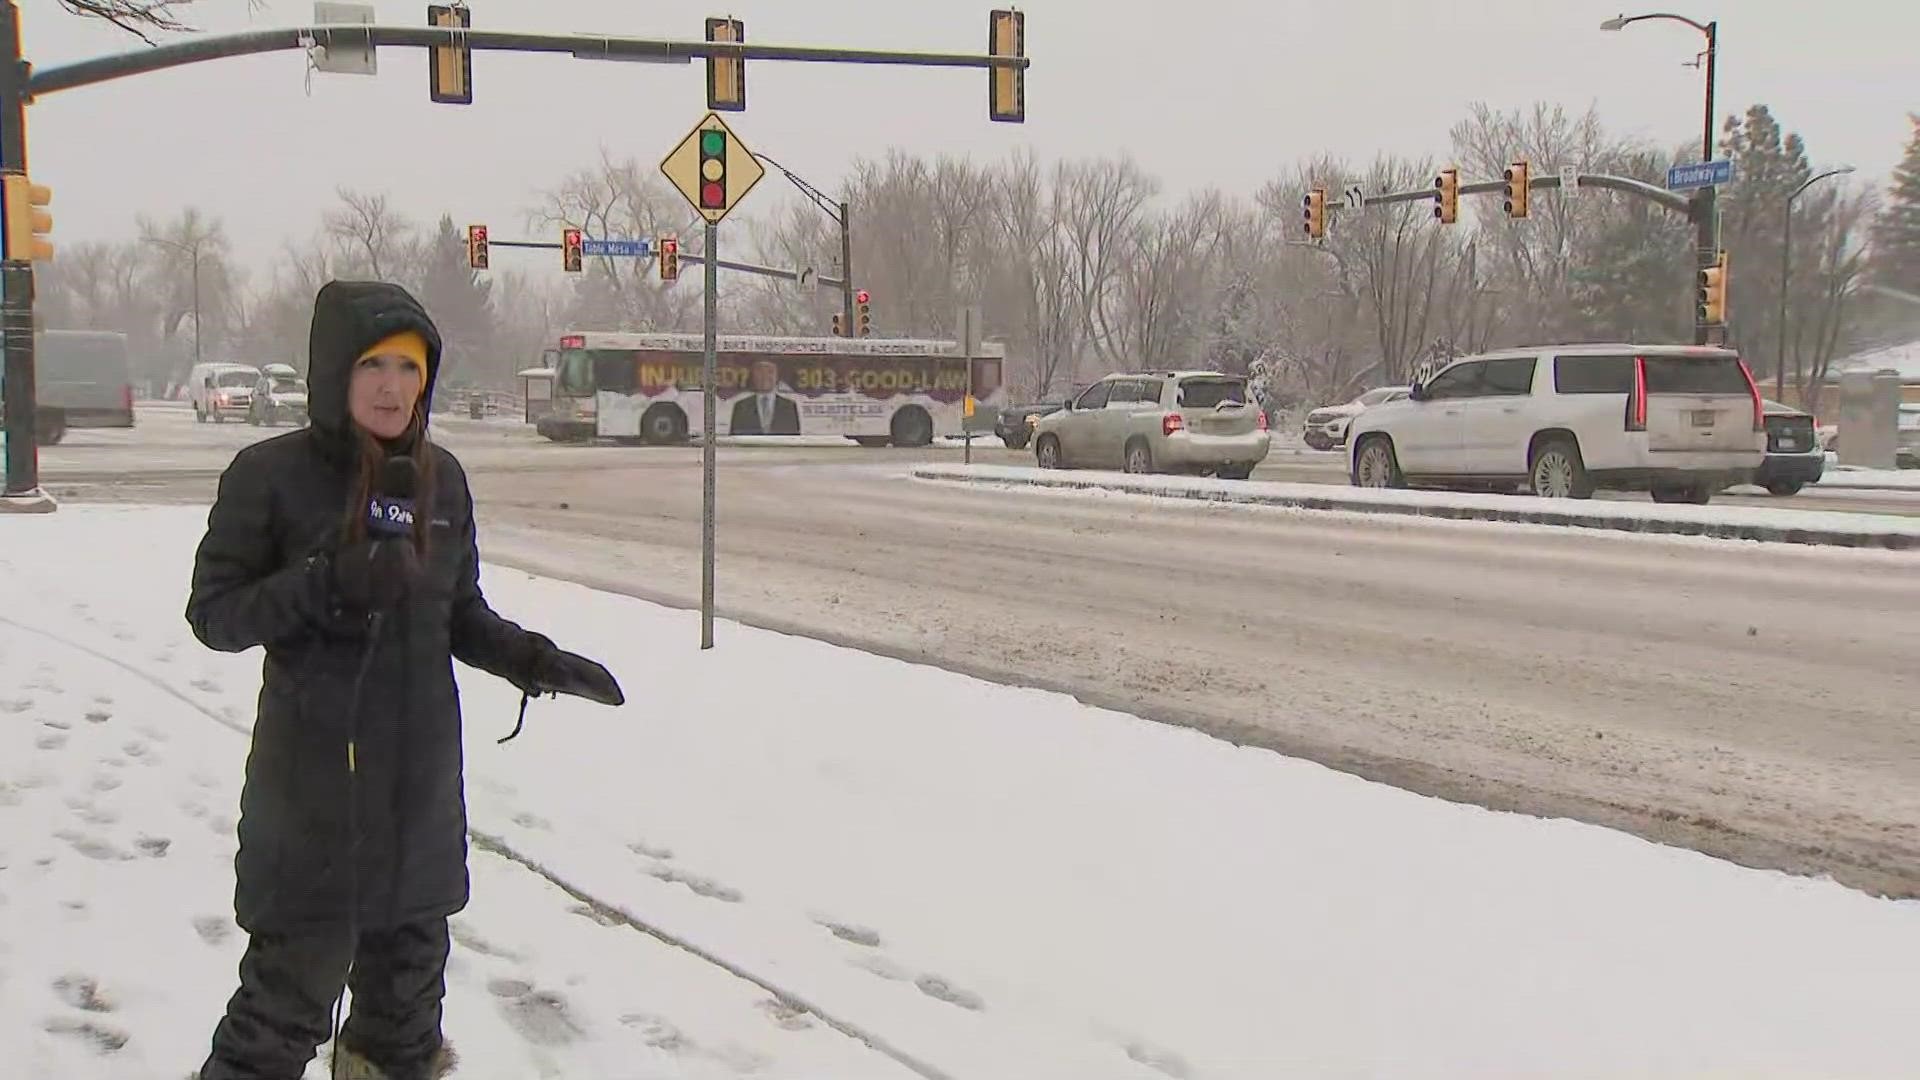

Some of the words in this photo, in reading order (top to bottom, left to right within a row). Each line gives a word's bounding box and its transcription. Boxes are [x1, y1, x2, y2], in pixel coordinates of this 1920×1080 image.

[1674, 167, 1714, 184] Broadway
[584, 243, 605, 254] Table
[608, 242, 630, 254] Mesa
[723, 341, 746, 349] BIKE
